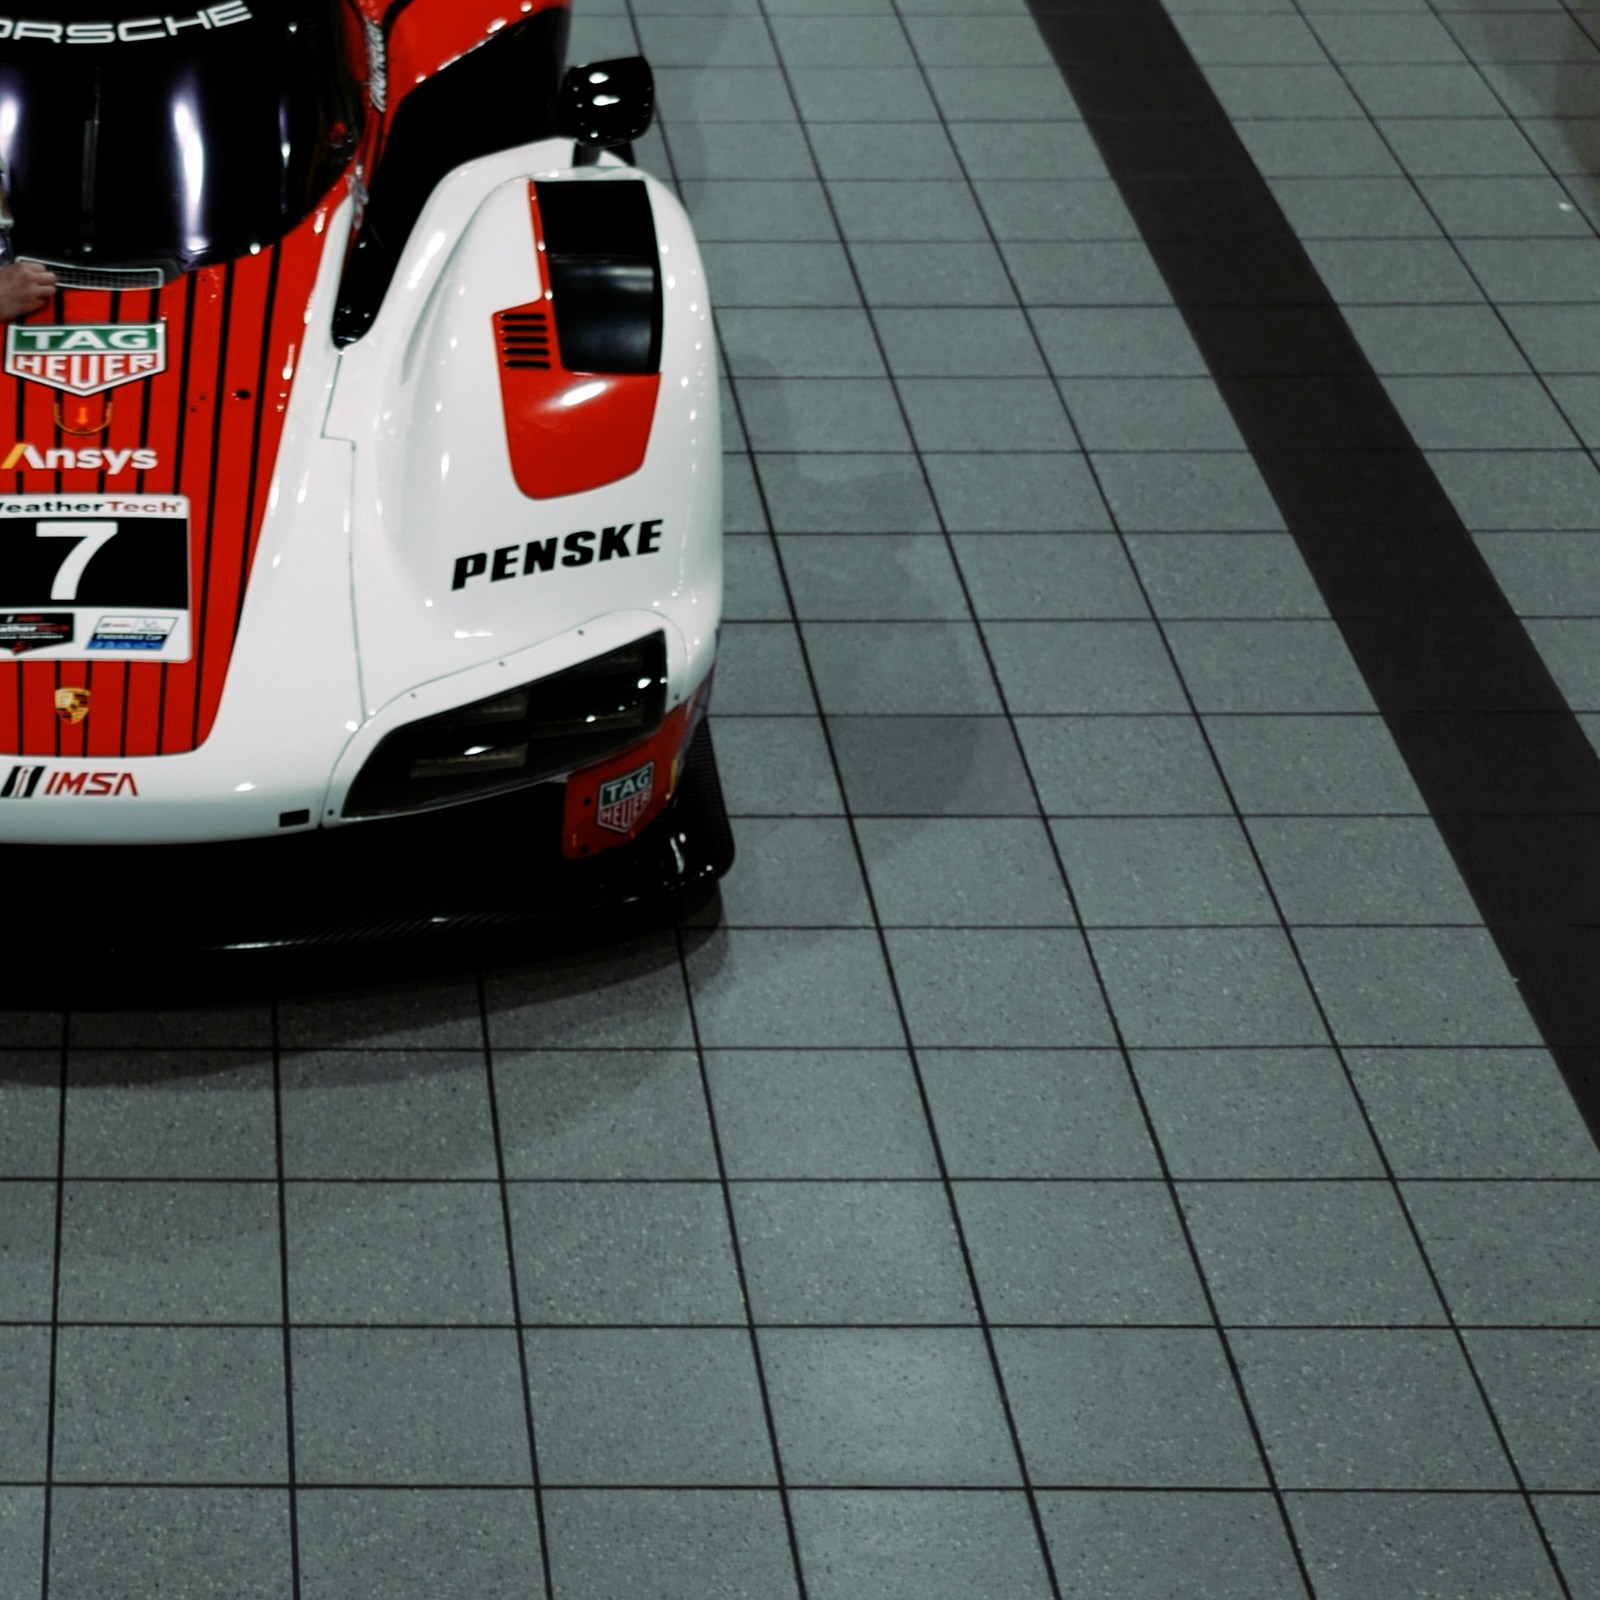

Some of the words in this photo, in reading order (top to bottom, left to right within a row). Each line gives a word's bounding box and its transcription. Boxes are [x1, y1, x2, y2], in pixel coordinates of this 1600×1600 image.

[21, 329, 149, 351] TAG
[15, 354, 157, 391] HEUER
[0, 443, 159, 476] Ansys
[35, 520, 119, 601] 7
[451, 519, 664, 592] PENSKE
[44, 771, 140, 798] IMSA
[605, 769, 650, 804] TAG
